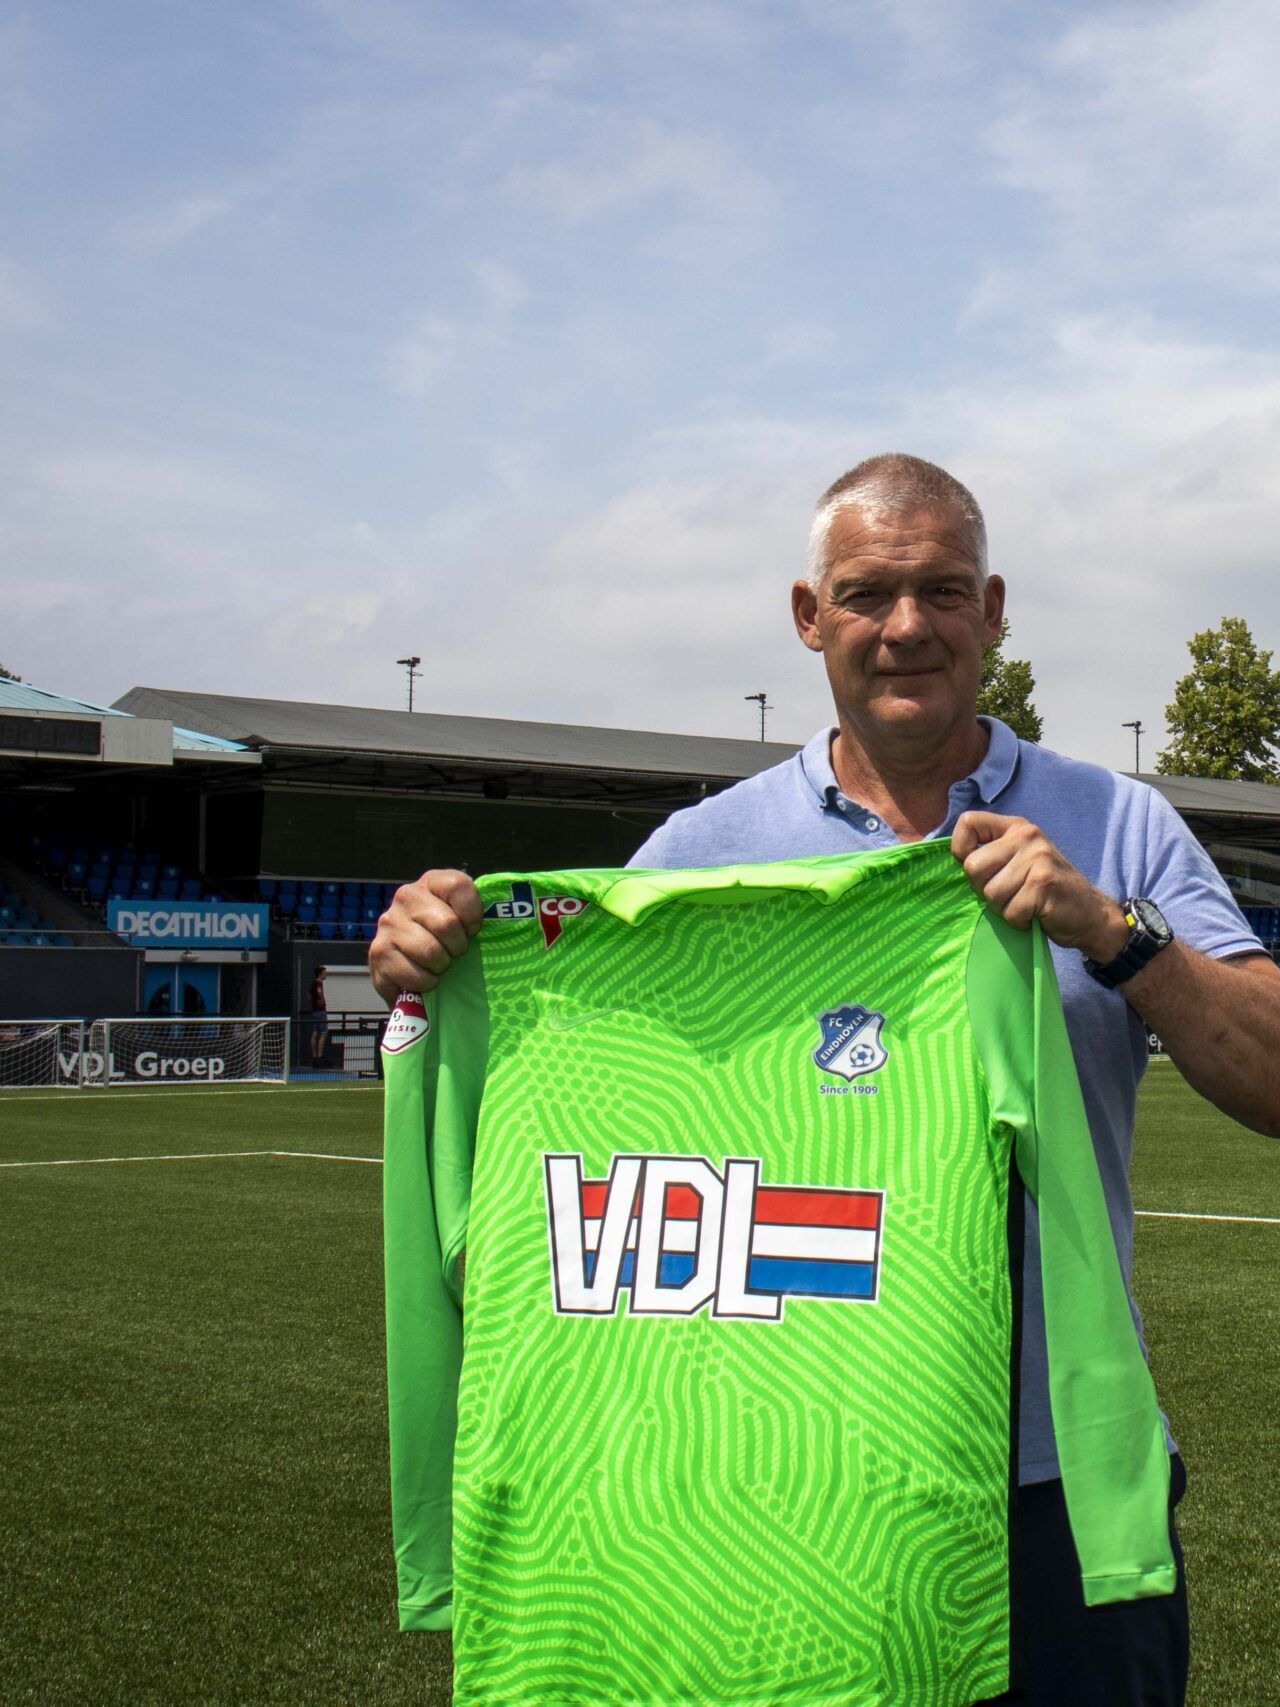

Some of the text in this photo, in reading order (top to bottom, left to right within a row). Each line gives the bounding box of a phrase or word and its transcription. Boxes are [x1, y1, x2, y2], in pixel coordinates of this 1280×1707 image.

[117, 911, 259, 939] DECATHLON
[829, 1017, 843, 1027] FC
[820, 1014, 865, 1061] EINDHOVEN
[57, 1052, 225, 1080] VDL Groep
[819, 1084, 878, 1094] Since 1909
[544, 1154, 783, 1321] VDL
